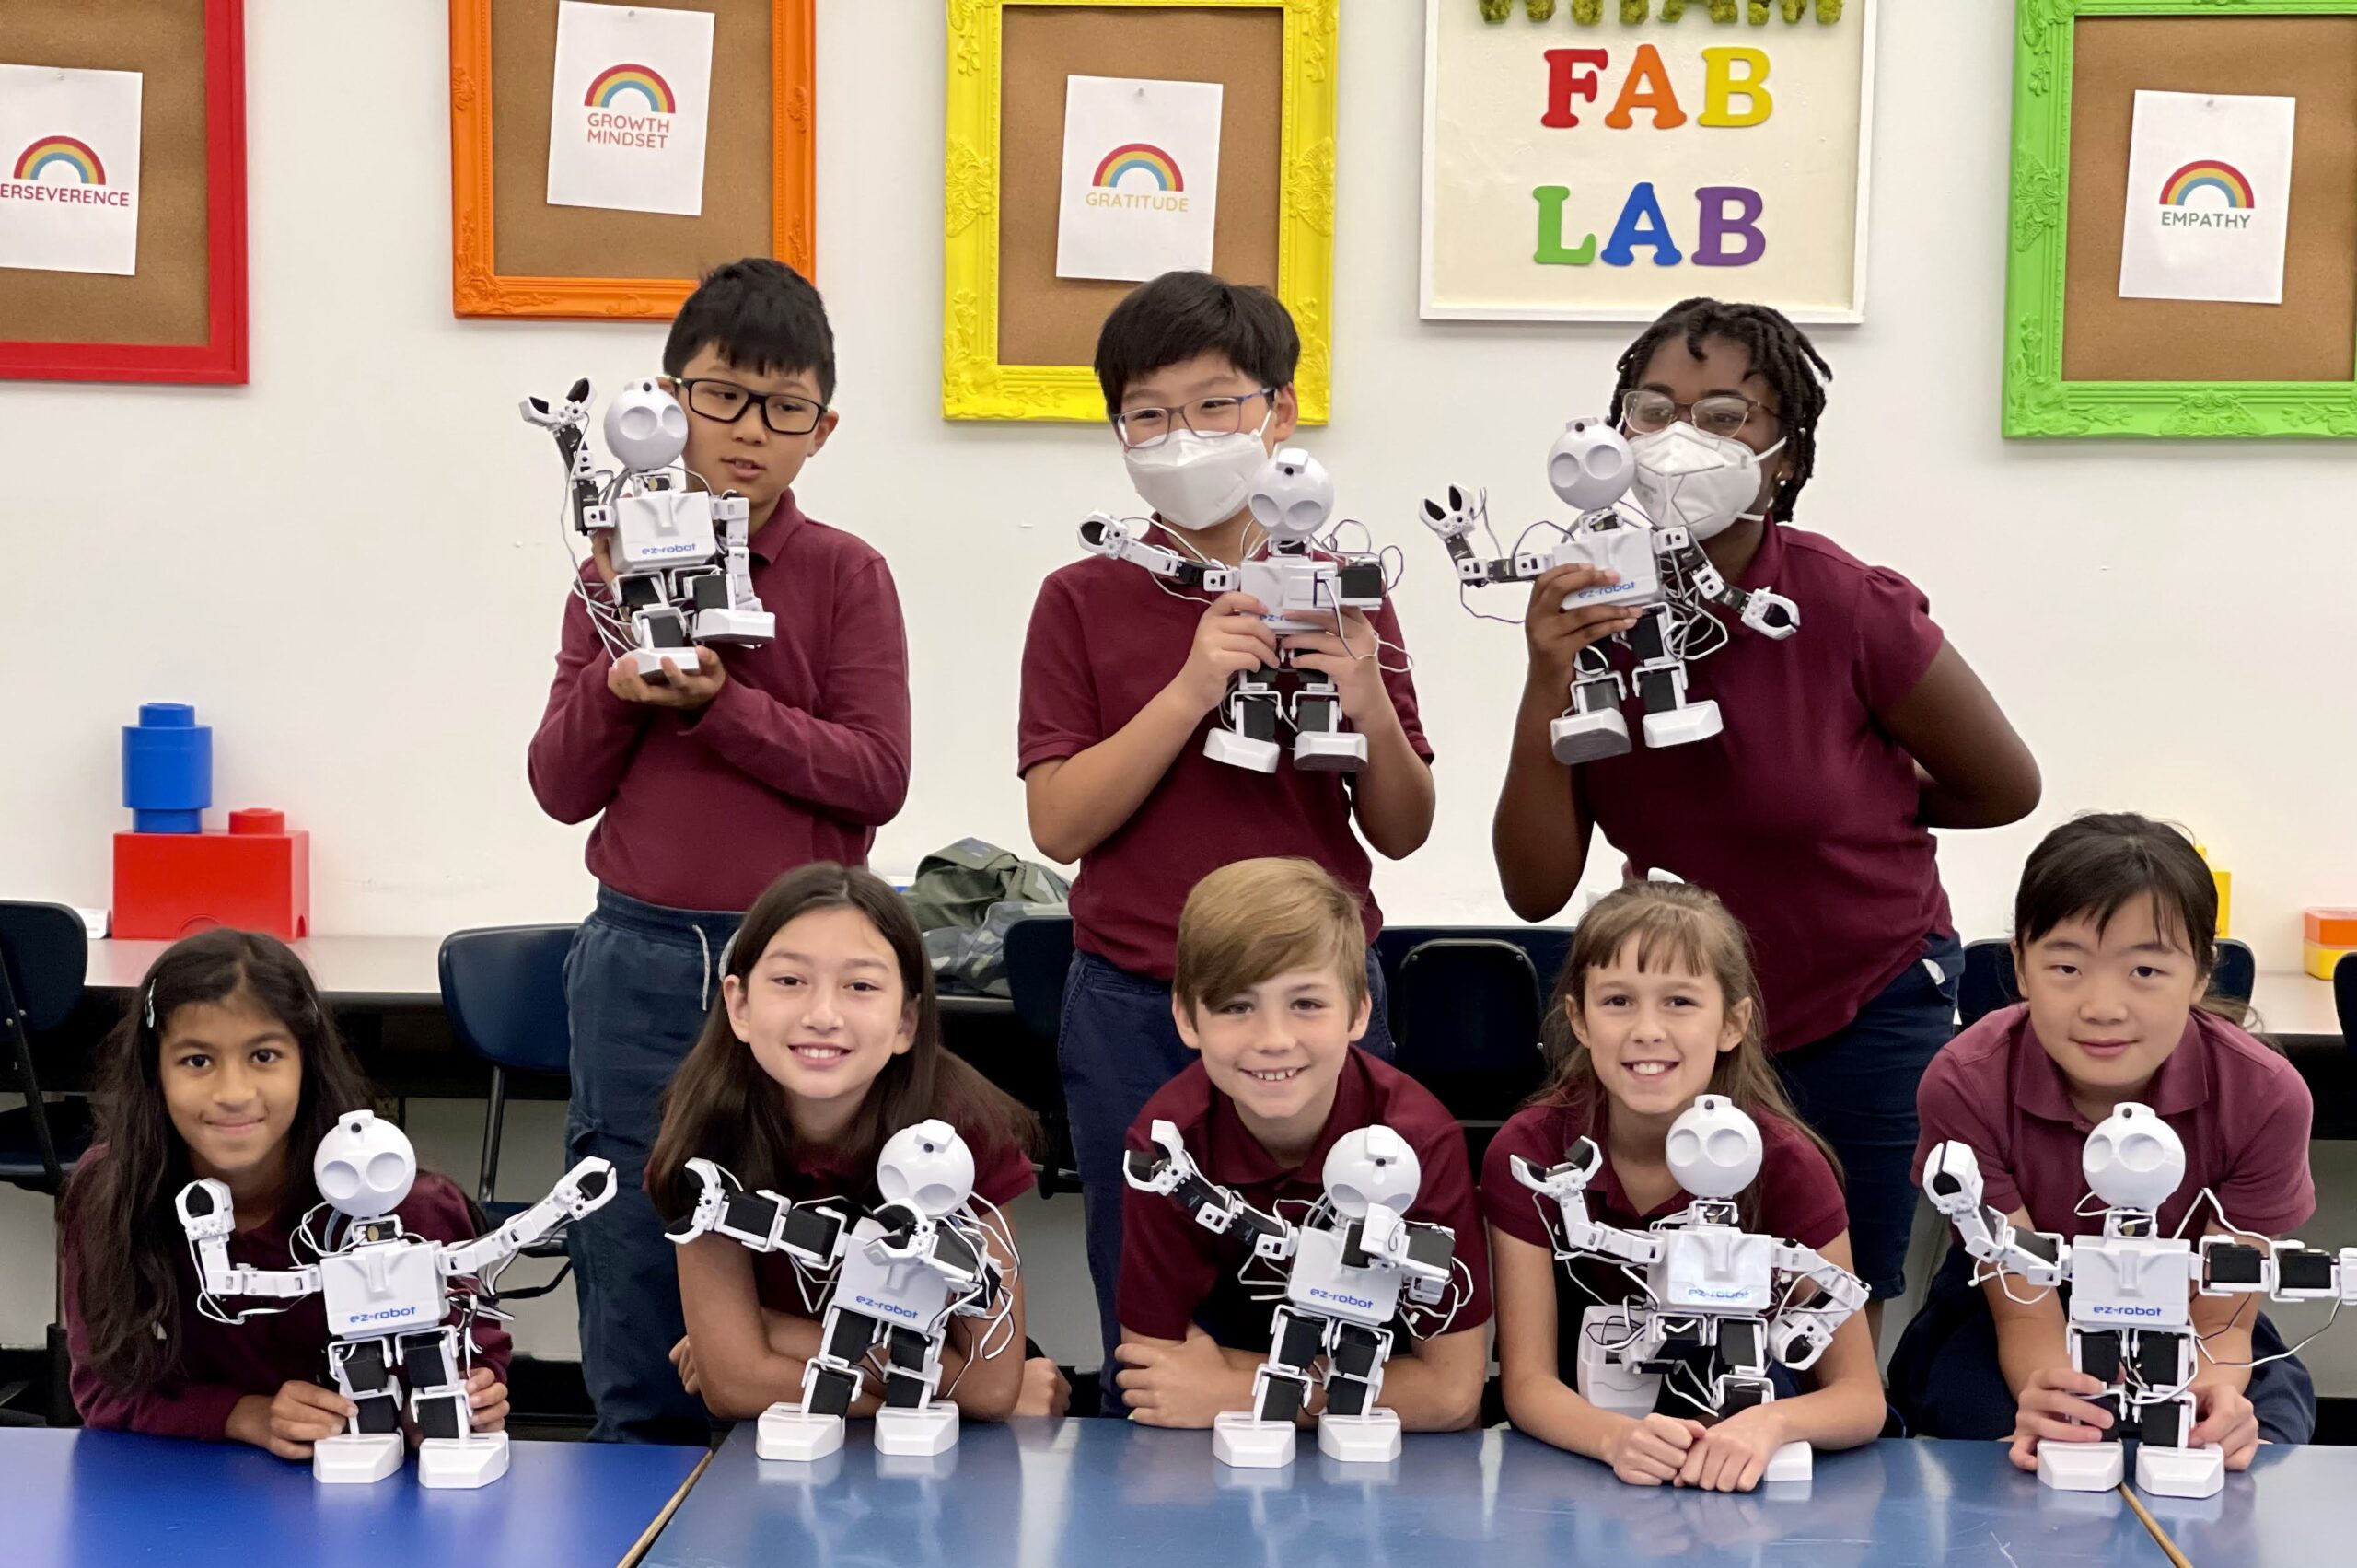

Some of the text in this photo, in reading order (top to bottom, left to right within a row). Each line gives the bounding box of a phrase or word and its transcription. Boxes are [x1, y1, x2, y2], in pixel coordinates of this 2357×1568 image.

[1540, 43, 1773, 130] FAB
[586, 111, 670, 134] GROWTH
[586, 128, 668, 149] MINDSET
[0, 183, 130, 207] ERSEVERENCE
[1085, 192, 1190, 213] GRATITUDE
[1532, 181, 1767, 267] LAB
[2160, 211, 2251, 229] EMPATHY
[641, 542, 696, 555] ez-robot
[1577, 581, 1636, 598] ez-robot
[855, 1295, 919, 1319] ez-robot
[1309, 1288, 1374, 1309] ez-robot
[349, 1306, 416, 1323] ez-robot
[2093, 1306, 2162, 1317] ez-robot
